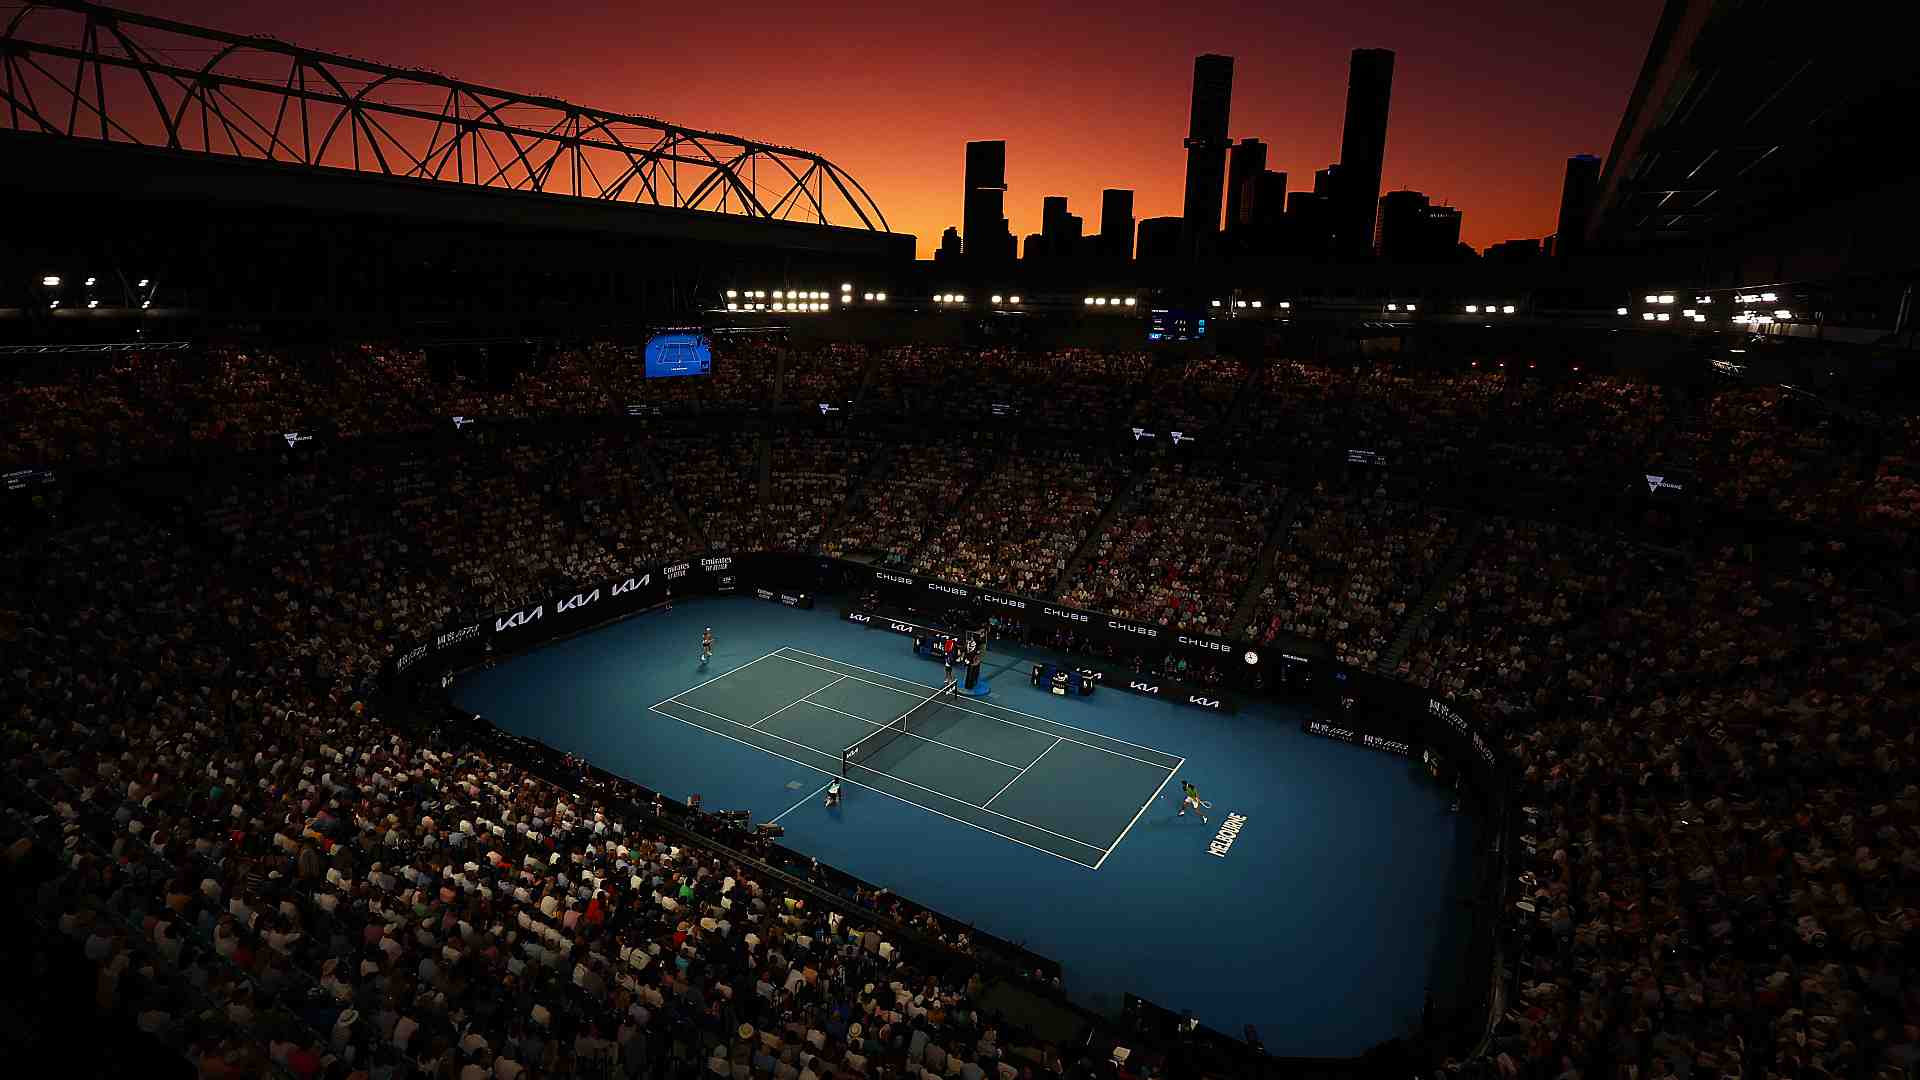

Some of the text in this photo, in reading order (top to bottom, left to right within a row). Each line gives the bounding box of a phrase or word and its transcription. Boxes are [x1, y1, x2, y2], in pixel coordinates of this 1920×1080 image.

[663, 562, 690, 576] Emirates
[701, 556, 732, 567] Emirates
[611, 573, 650, 597] KIA
[876, 572, 912, 585] CHUBB
[927, 582, 968, 597] CHUBB
[556, 588, 600, 613] KIA
[983, 594, 1026, 609] CHUBB
[495, 606, 542, 632] KIA
[1043, 606, 1089, 623] CHUBB
[1108, 621, 1158, 637] CHUBB
[1178, 636, 1231, 652] CHUBB
[1207, 811, 1248, 858] MELBOURNE
